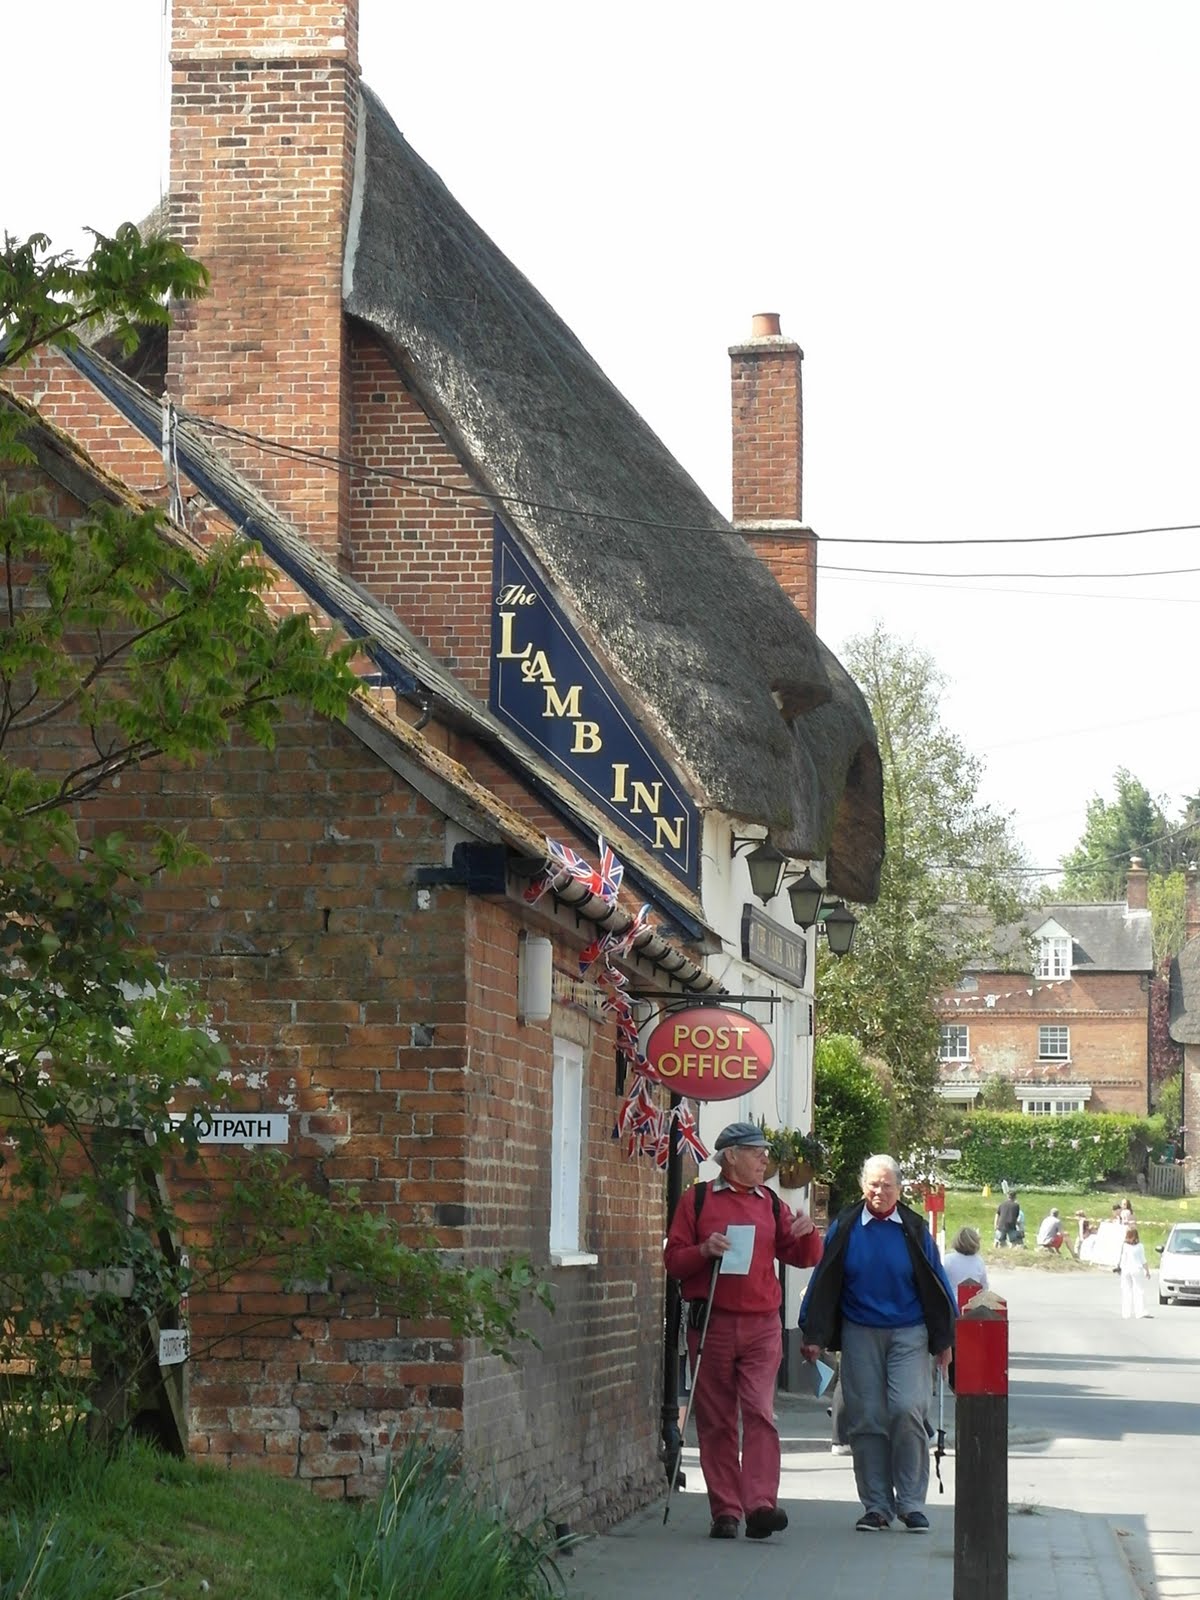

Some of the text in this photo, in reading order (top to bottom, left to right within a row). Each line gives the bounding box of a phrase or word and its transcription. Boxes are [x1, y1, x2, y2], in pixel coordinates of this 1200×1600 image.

[495, 584, 537, 606] The
[496, 612, 684, 849] LAMB INN
[673, 1025, 750, 1049] POST
[657, 1053, 757, 1079] OFFICE
[170, 1120, 271, 1137] FOTPATH
